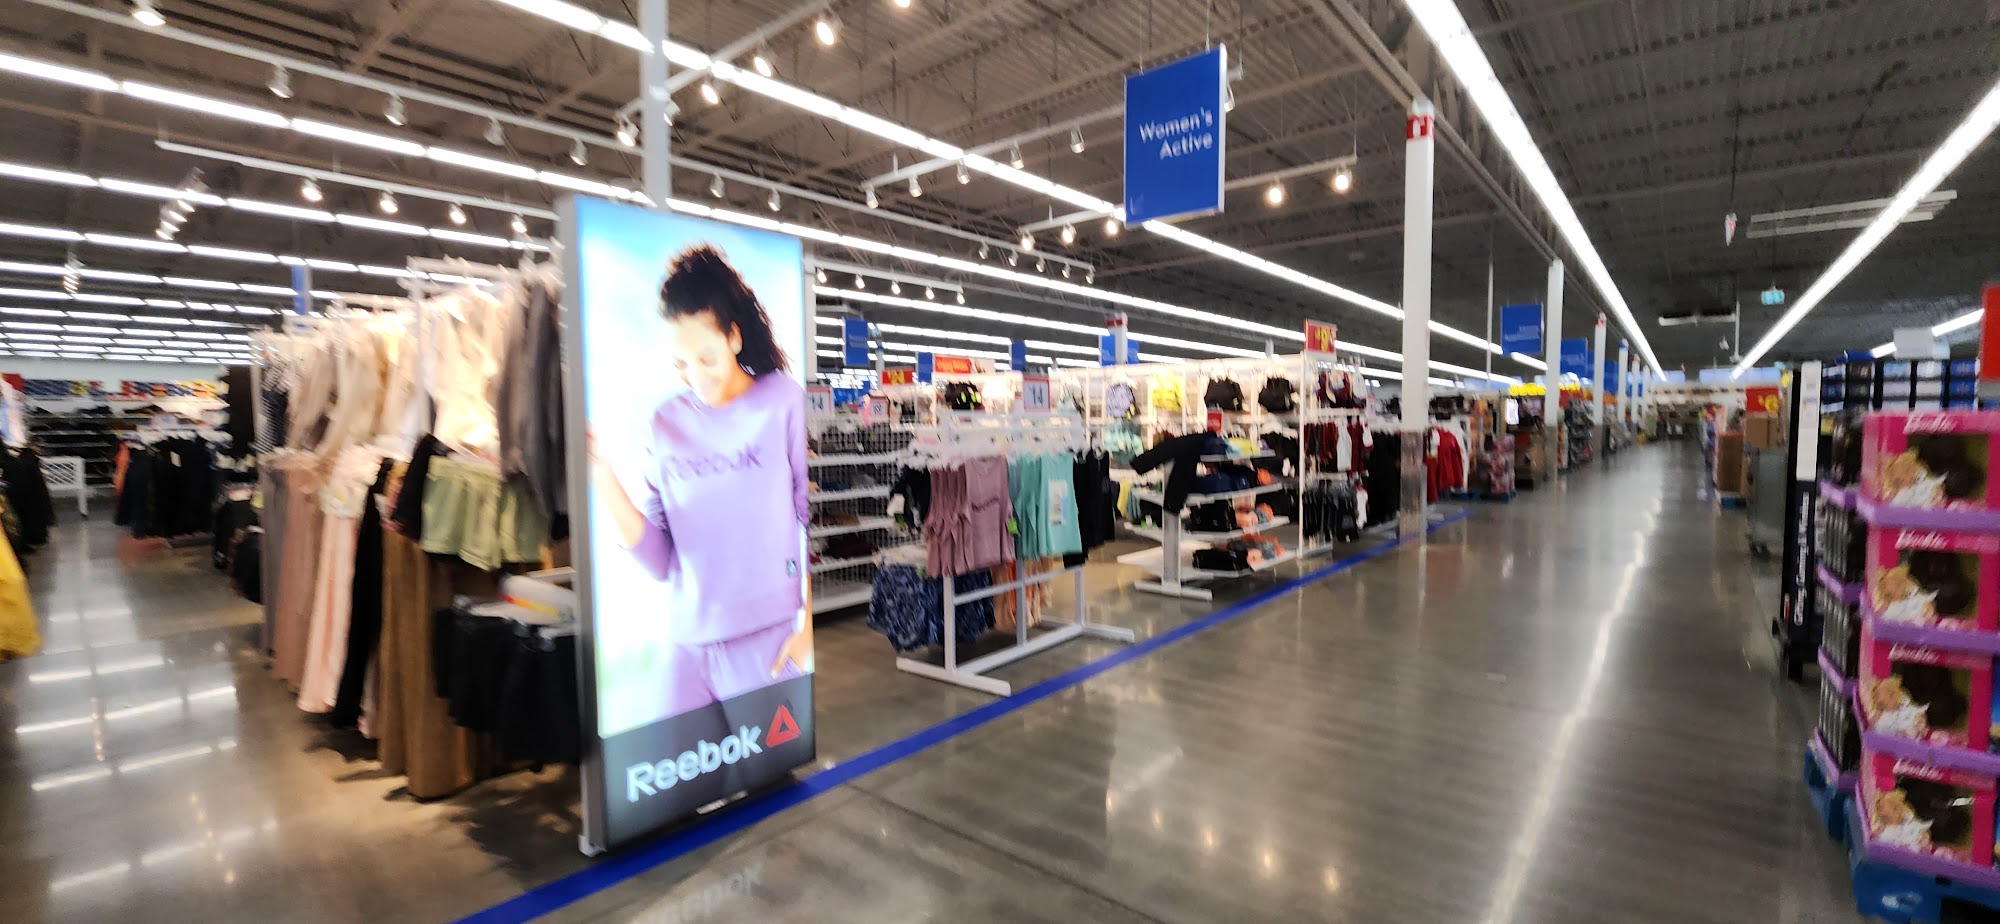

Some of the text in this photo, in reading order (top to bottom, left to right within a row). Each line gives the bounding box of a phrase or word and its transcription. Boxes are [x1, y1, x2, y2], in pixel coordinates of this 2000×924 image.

[1139, 107, 1213, 144] Women's
[1160, 132, 1213, 160] Active
[626, 725, 763, 803] Reebok
